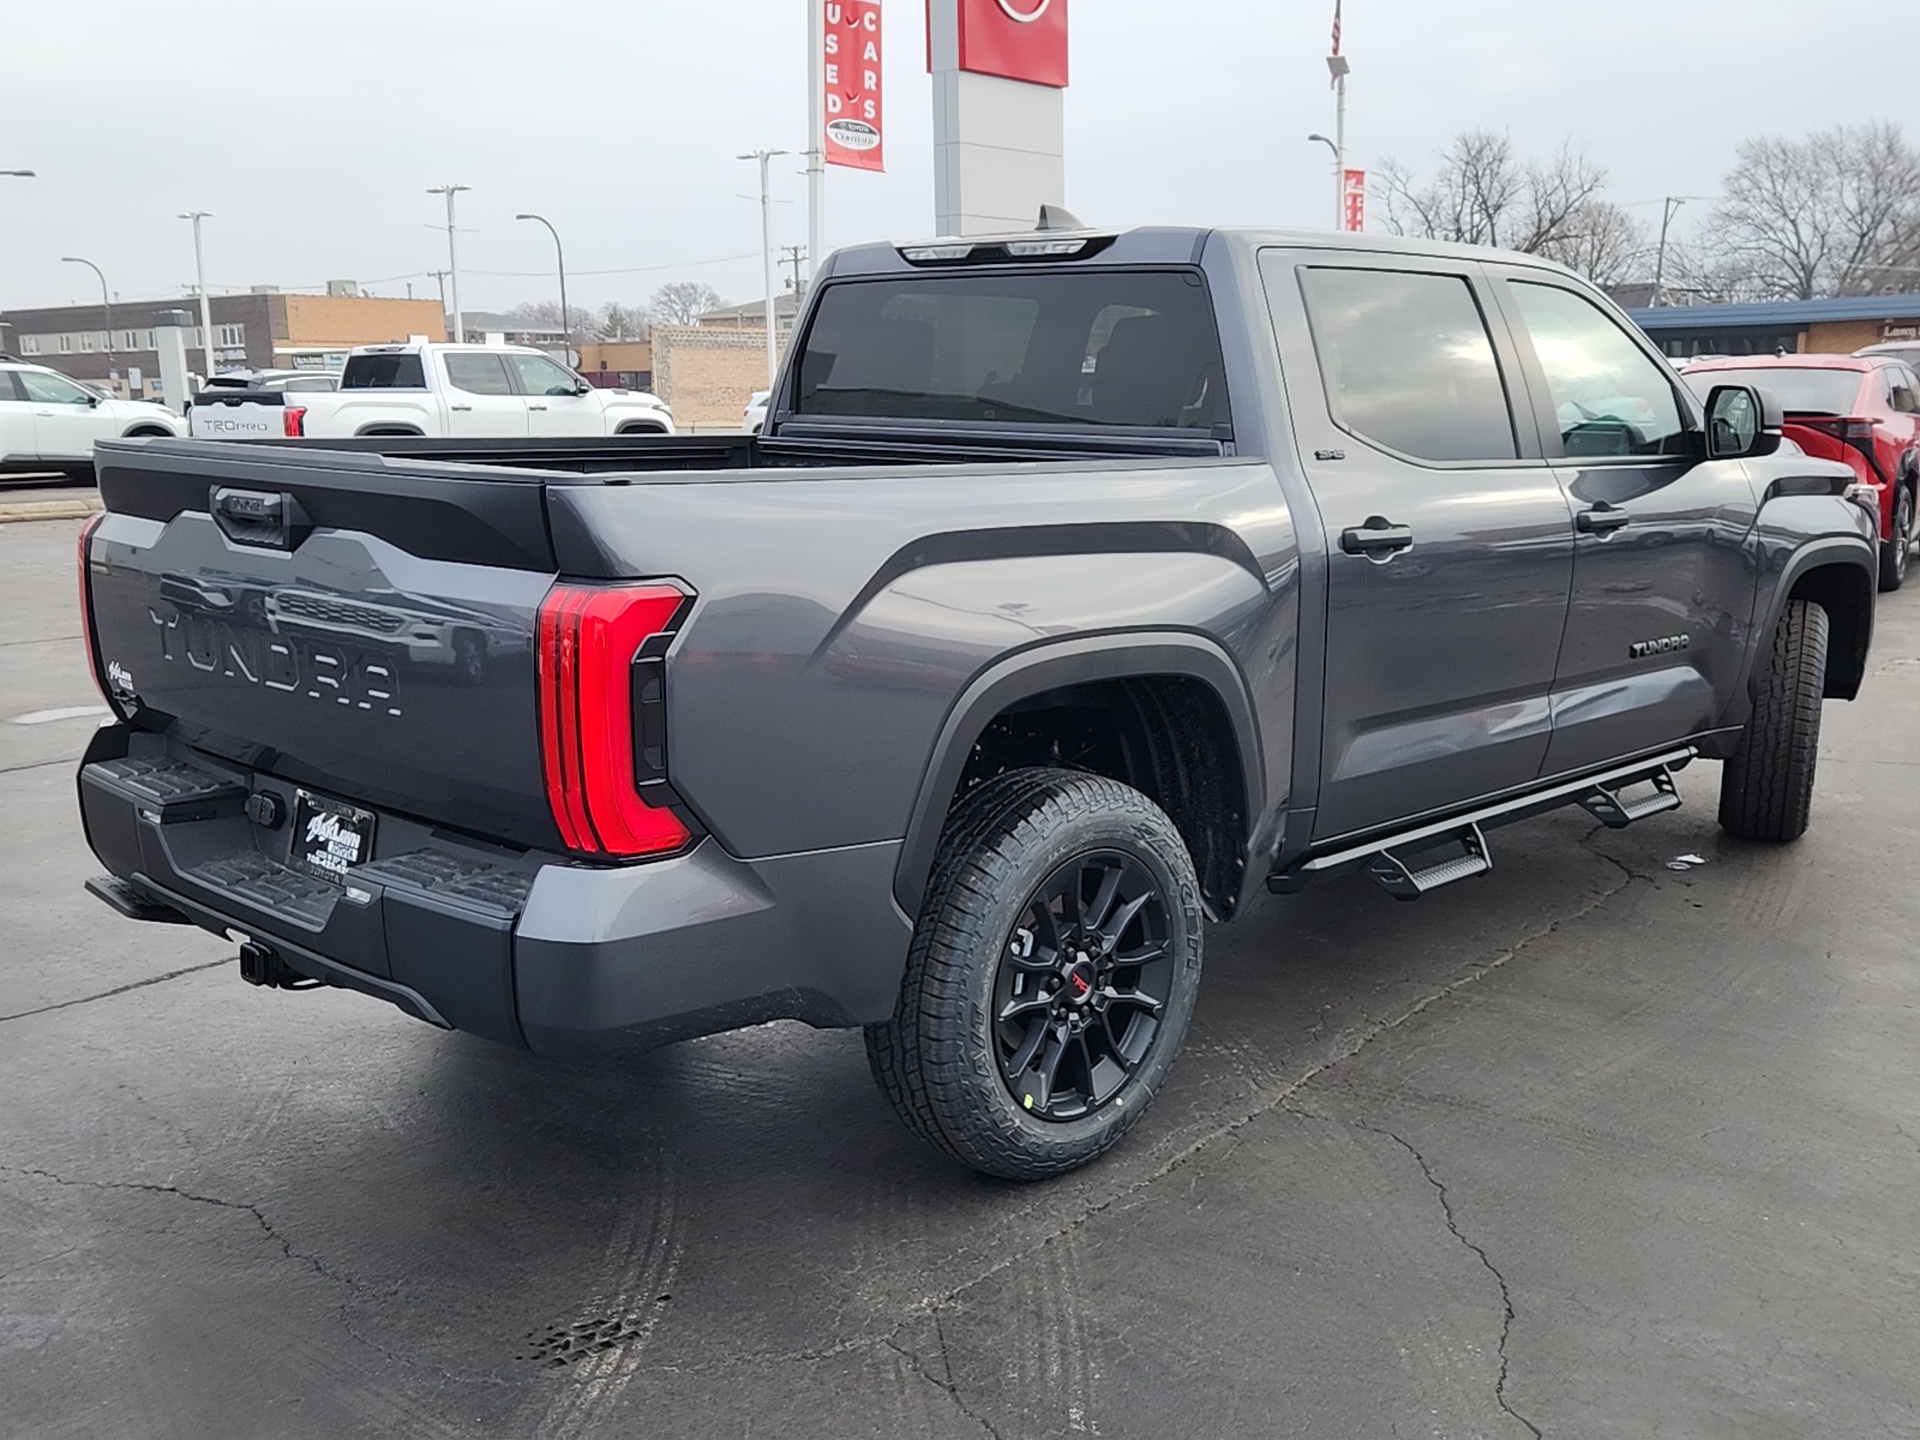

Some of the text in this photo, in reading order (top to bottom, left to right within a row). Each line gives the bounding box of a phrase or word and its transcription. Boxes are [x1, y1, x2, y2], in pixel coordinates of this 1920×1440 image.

[826, 3, 842, 114] USED
[863, 11, 878, 119] CARS
[848, 123, 870, 133] TOYOTA
[204, 419, 268, 433] TRD PRO
[1630, 633, 1690, 658] TUNDRA
[148, 607, 401, 716] TUNDRA
[310, 866, 341, 884] TOYOTA
[1072, 971, 1090, 993] TRD
